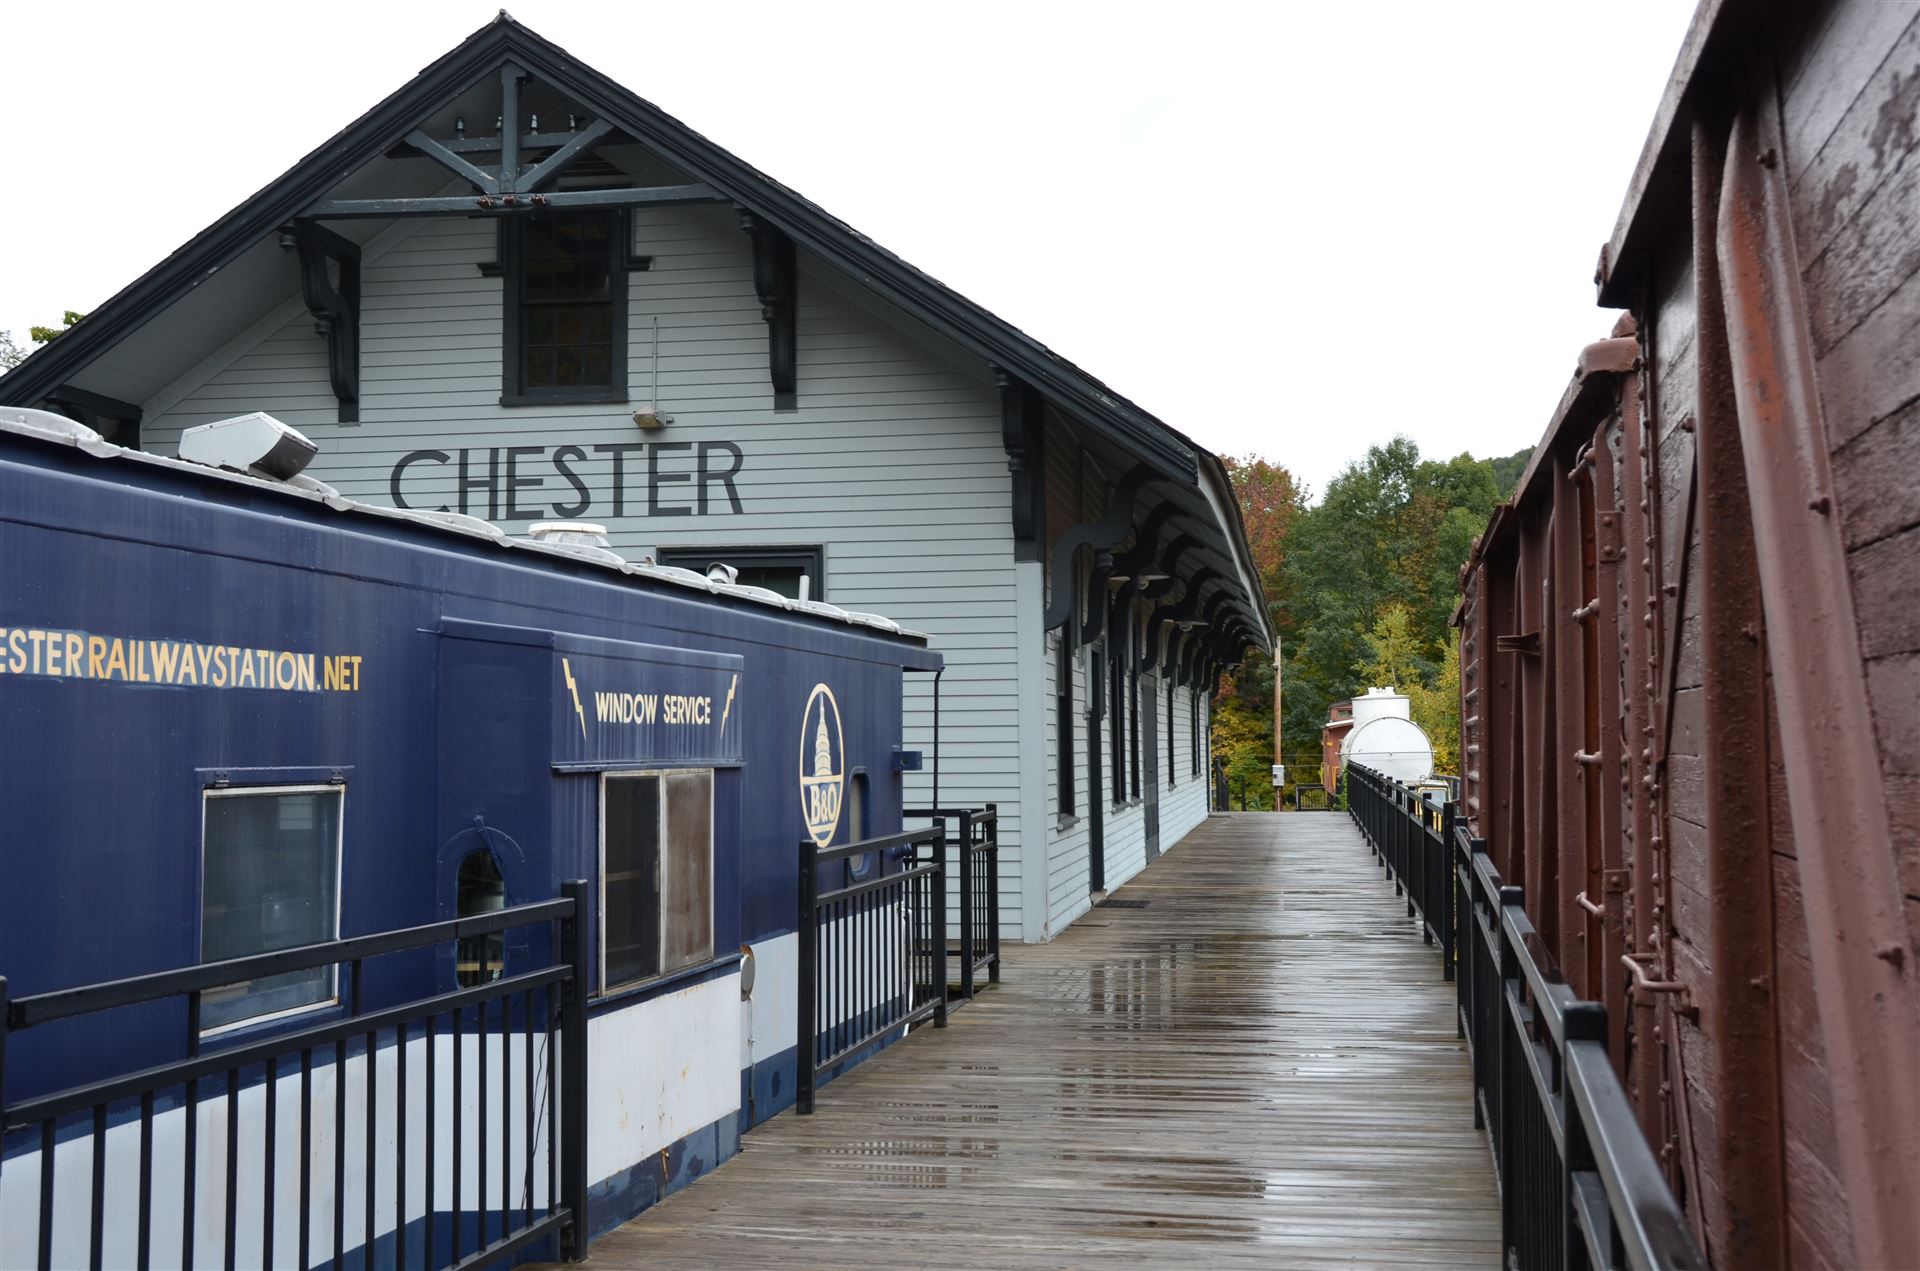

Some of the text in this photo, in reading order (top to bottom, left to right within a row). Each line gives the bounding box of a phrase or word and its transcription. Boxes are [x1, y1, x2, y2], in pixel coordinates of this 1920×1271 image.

[390, 441, 744, 520] CHESTER
[595, 691, 711, 725] WINDOW SERVICE
[809, 783, 838, 825] B&O
